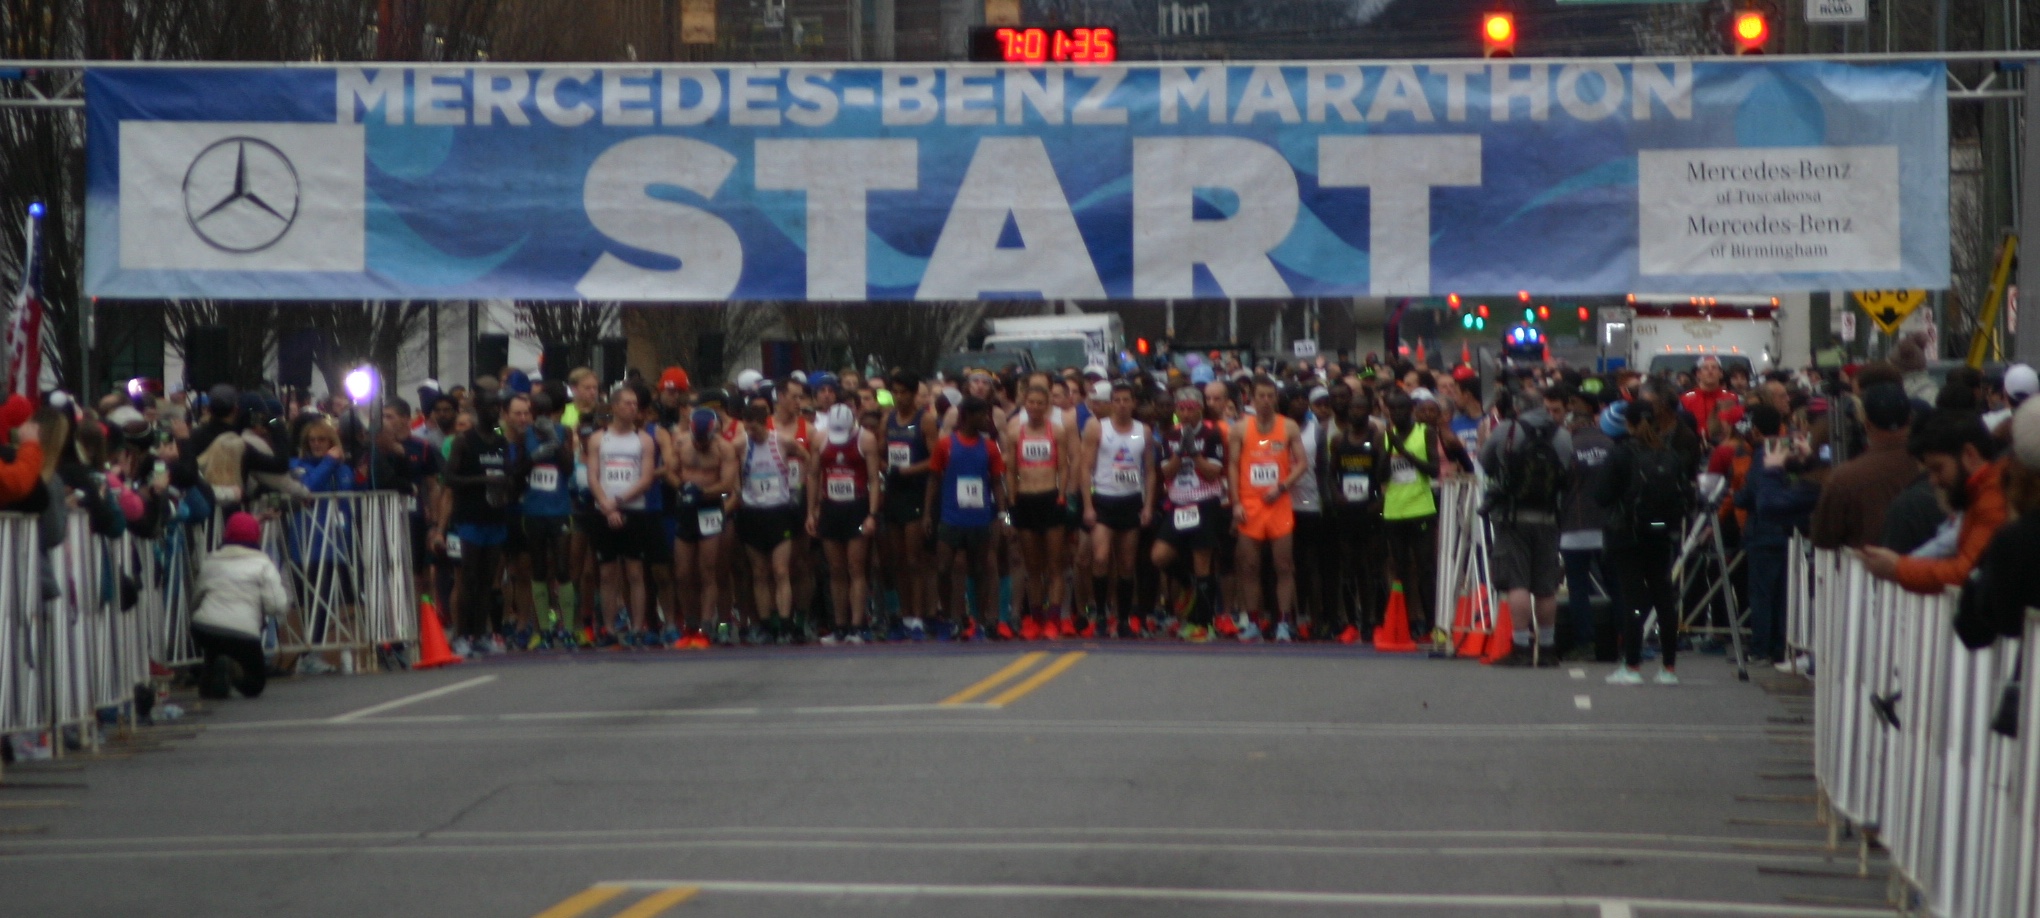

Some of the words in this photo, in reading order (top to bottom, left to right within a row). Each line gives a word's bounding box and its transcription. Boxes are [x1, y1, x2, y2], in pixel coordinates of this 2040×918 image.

[336, 67, 1128, 127] MERCEDES-BENZ
[1159, 61, 1693, 124] MARATHON
[1687, 159, 1852, 182] Mercedes-Benz
[1716, 189, 1731, 205] of
[1738, 188, 1822, 204] Tuscaloosa
[574, 134, 1482, 300] START
[1687, 213, 1853, 236] Mercedes-Benz
[1710, 242, 1727, 258] of
[1731, 242, 1828, 260] Birmingham
